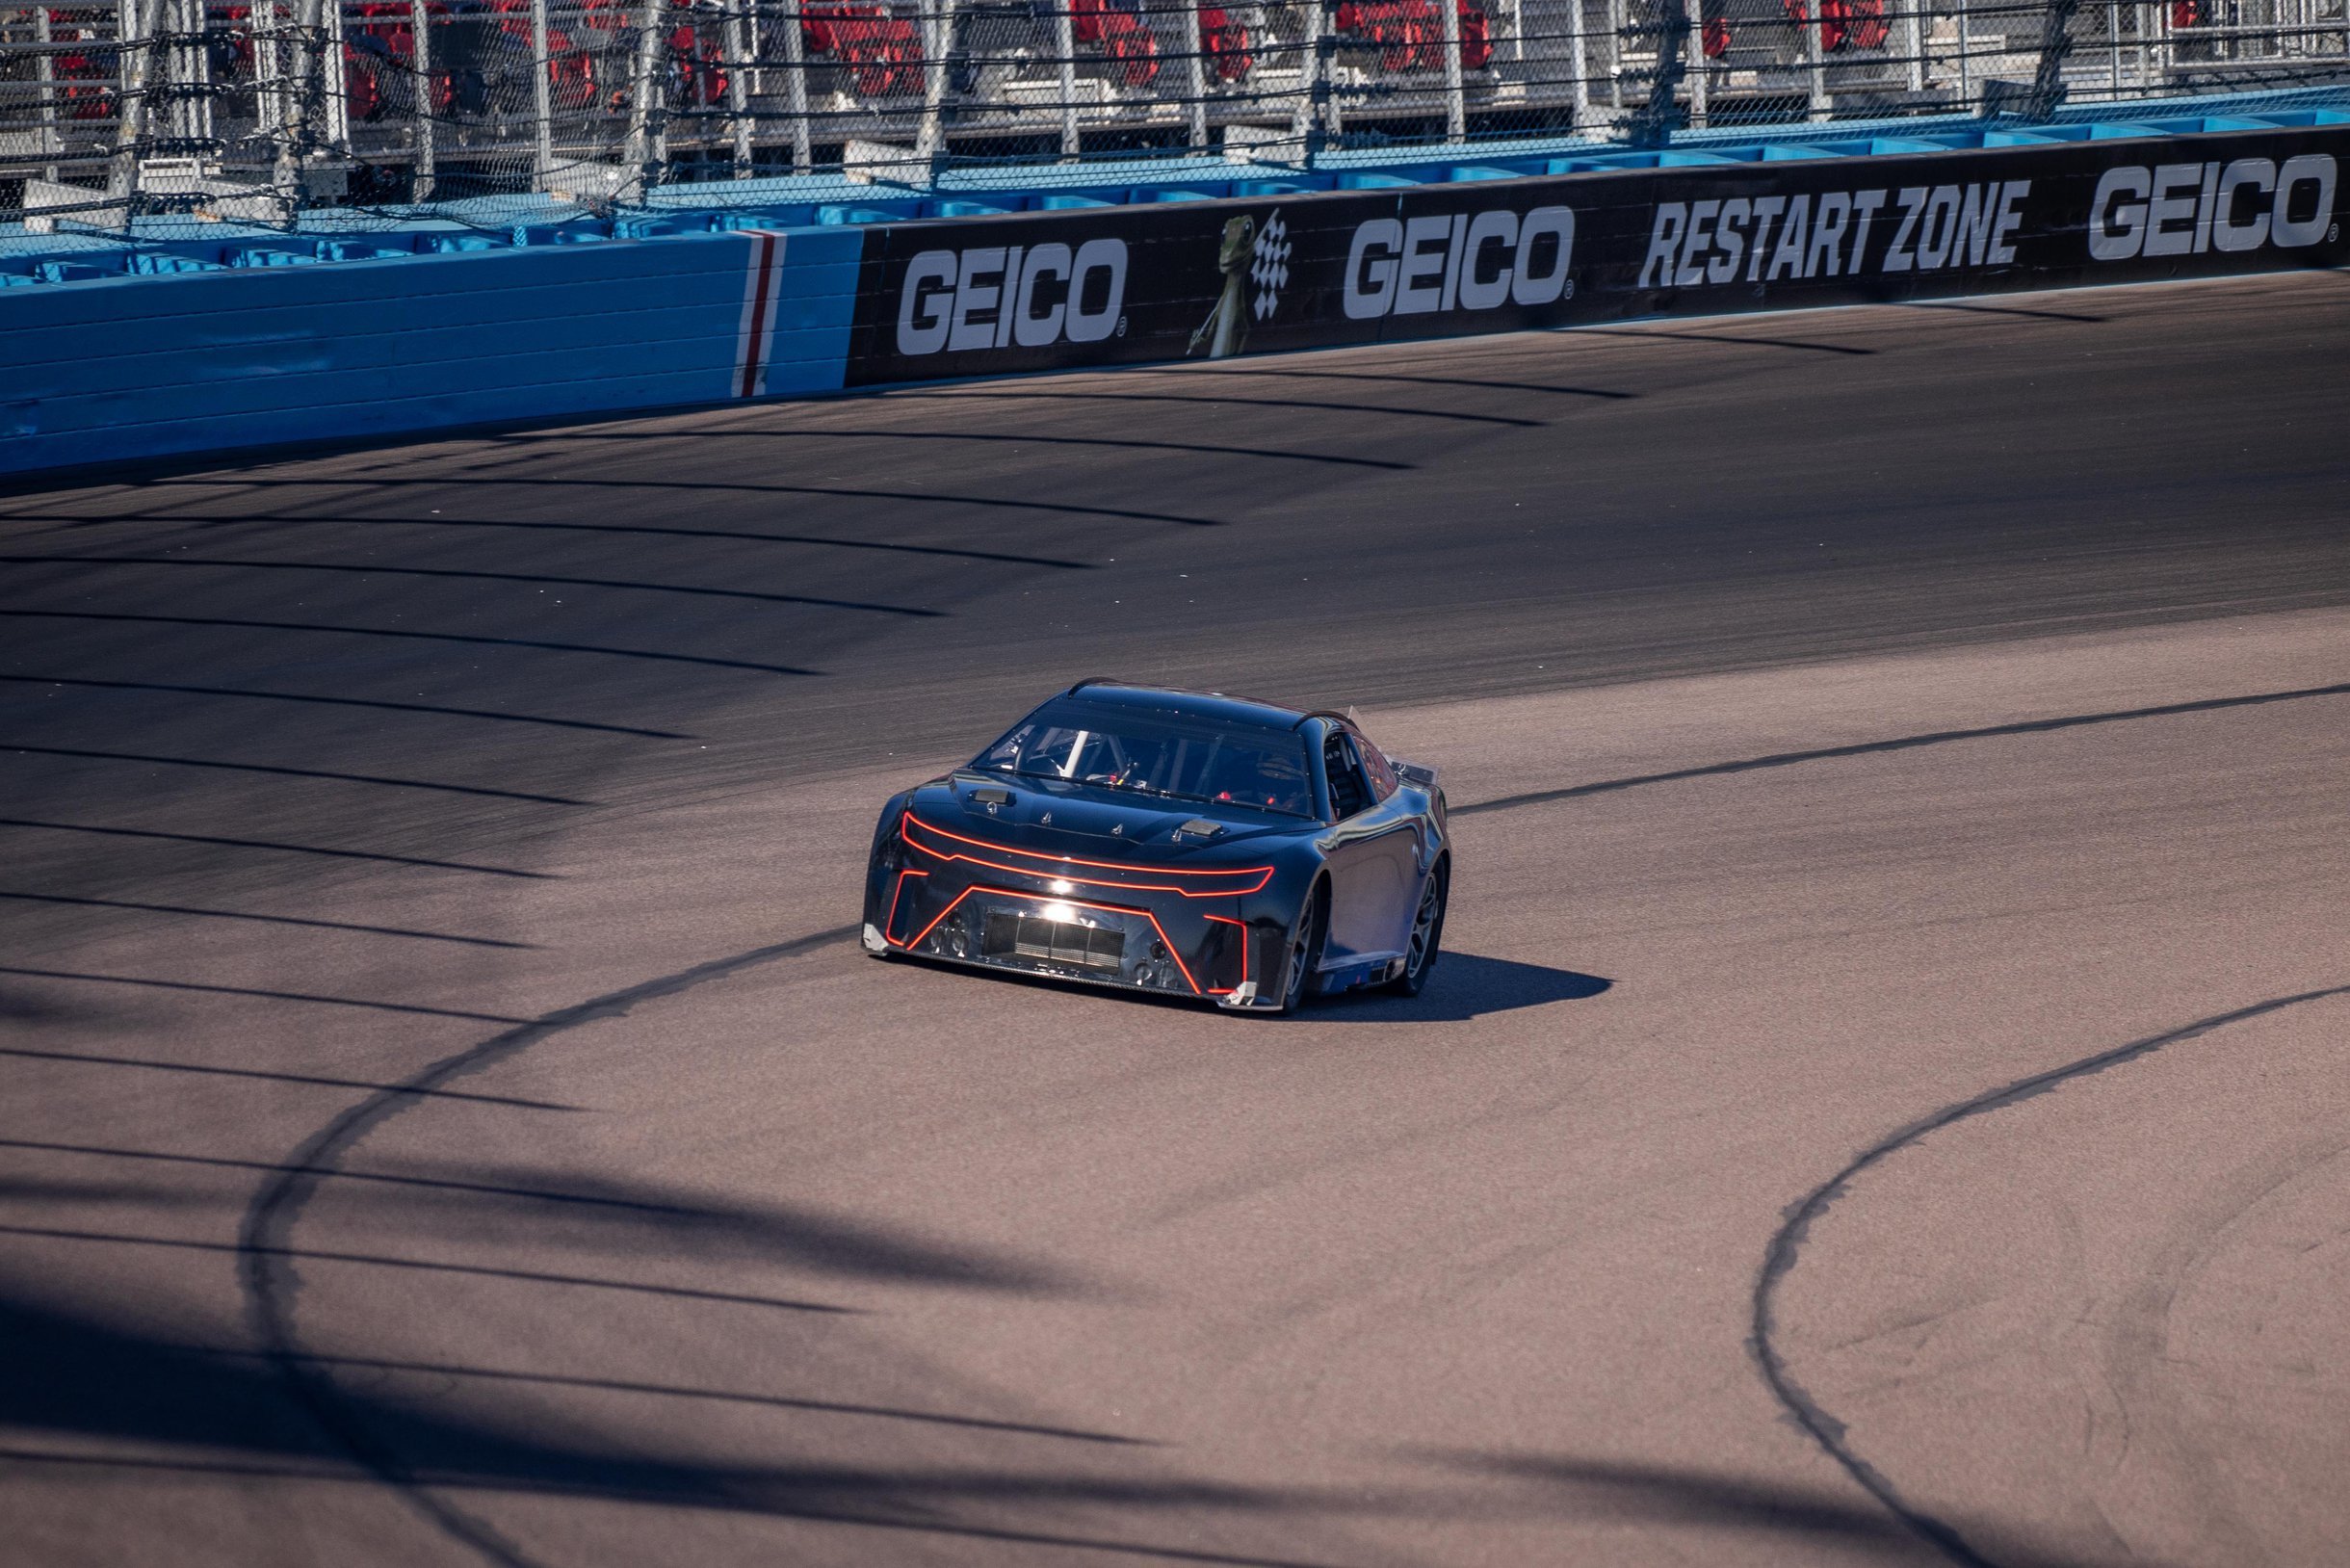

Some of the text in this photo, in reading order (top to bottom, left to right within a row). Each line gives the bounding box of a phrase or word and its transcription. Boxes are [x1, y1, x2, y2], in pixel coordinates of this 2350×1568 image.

[1344, 205, 1576, 320] GEICO
[1638, 180, 2031, 288] RESTART ZONE
[2088, 154, 2338, 261] GEICO
[896, 238, 1129, 355] GEICO
